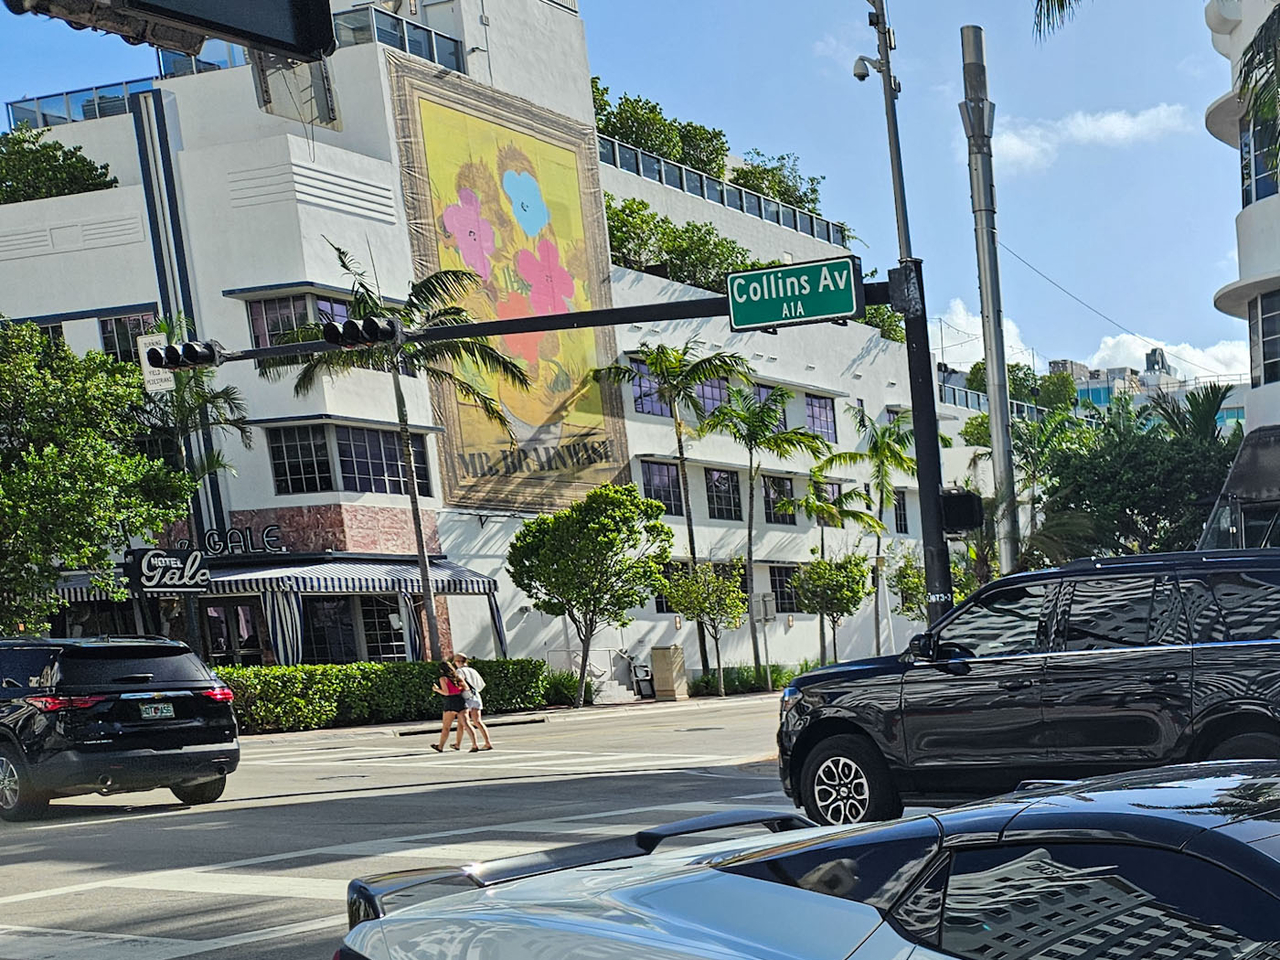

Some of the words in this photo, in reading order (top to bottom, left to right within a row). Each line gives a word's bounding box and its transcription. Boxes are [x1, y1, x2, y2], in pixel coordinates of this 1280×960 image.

[733, 272, 810, 303] Collins
[818, 266, 847, 292] Av
[782, 301, 805, 318] A1A
[458, 451, 500, 479] MR.
[500, 439, 619, 476] BRAINWASH
[205, 524, 280, 555] GALE
[140, 550, 210, 587] Gale
[150, 557, 183, 568] HOTEL
